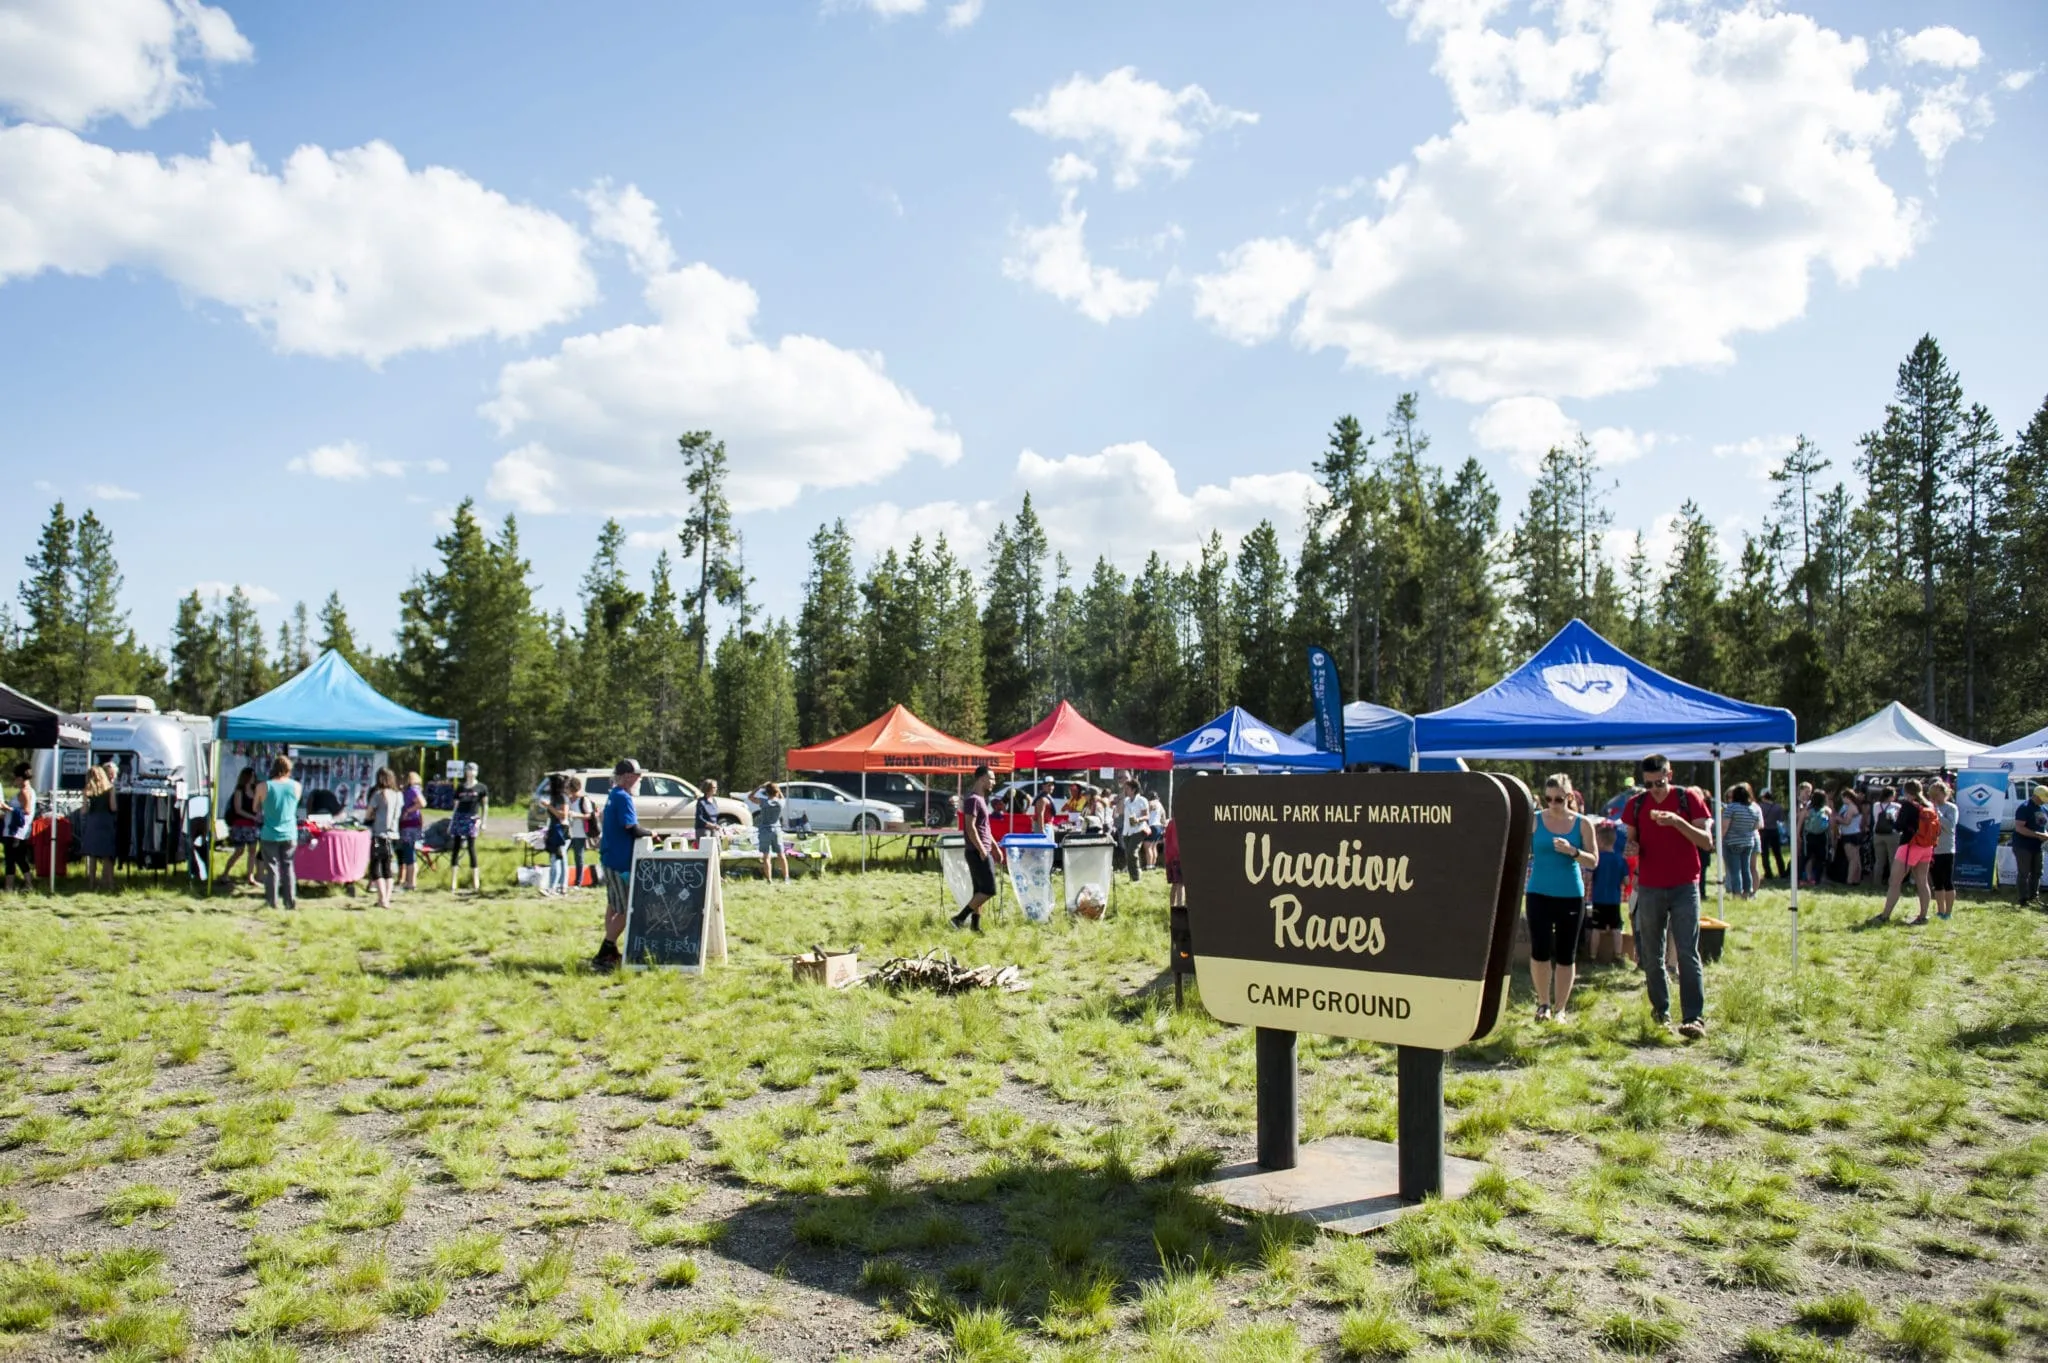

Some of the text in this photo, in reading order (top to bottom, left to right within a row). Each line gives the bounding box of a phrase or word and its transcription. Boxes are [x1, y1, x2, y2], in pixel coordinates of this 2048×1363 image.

[884, 754, 920, 767] Works
[922, 754, 959, 767] Where
[1214, 805, 1452, 824] NATIONAL PARK HALF MARATHON
[1245, 832, 1414, 893] Vacation
[1270, 893, 1386, 955] Races
[1247, 983, 1411, 1020] CAMPGROUND
